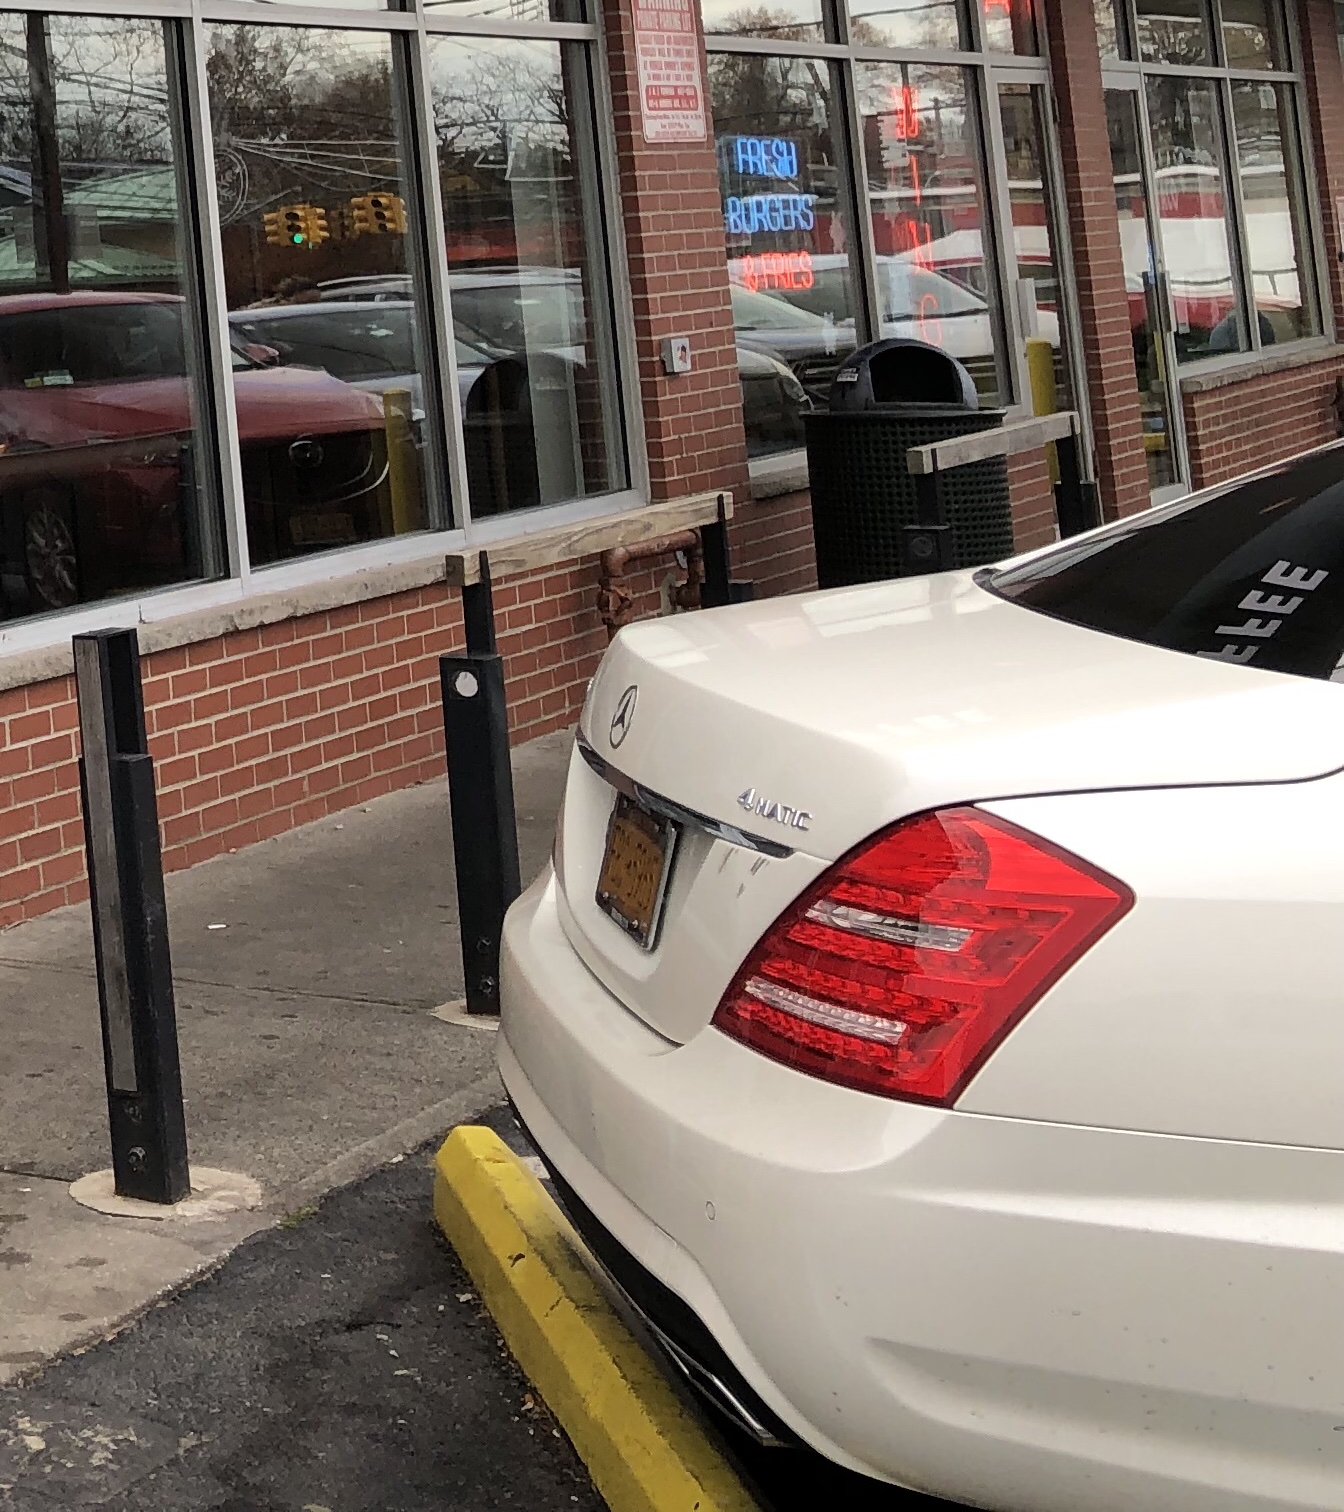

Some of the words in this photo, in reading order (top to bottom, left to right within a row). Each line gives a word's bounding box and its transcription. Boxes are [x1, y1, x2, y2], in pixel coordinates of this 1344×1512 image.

[736, 138, 798, 179] FRESH
[727, 194, 814, 234] BURGERS
[761, 250, 815, 289] FRIES
[736, 787, 813, 832] 4MATIC
